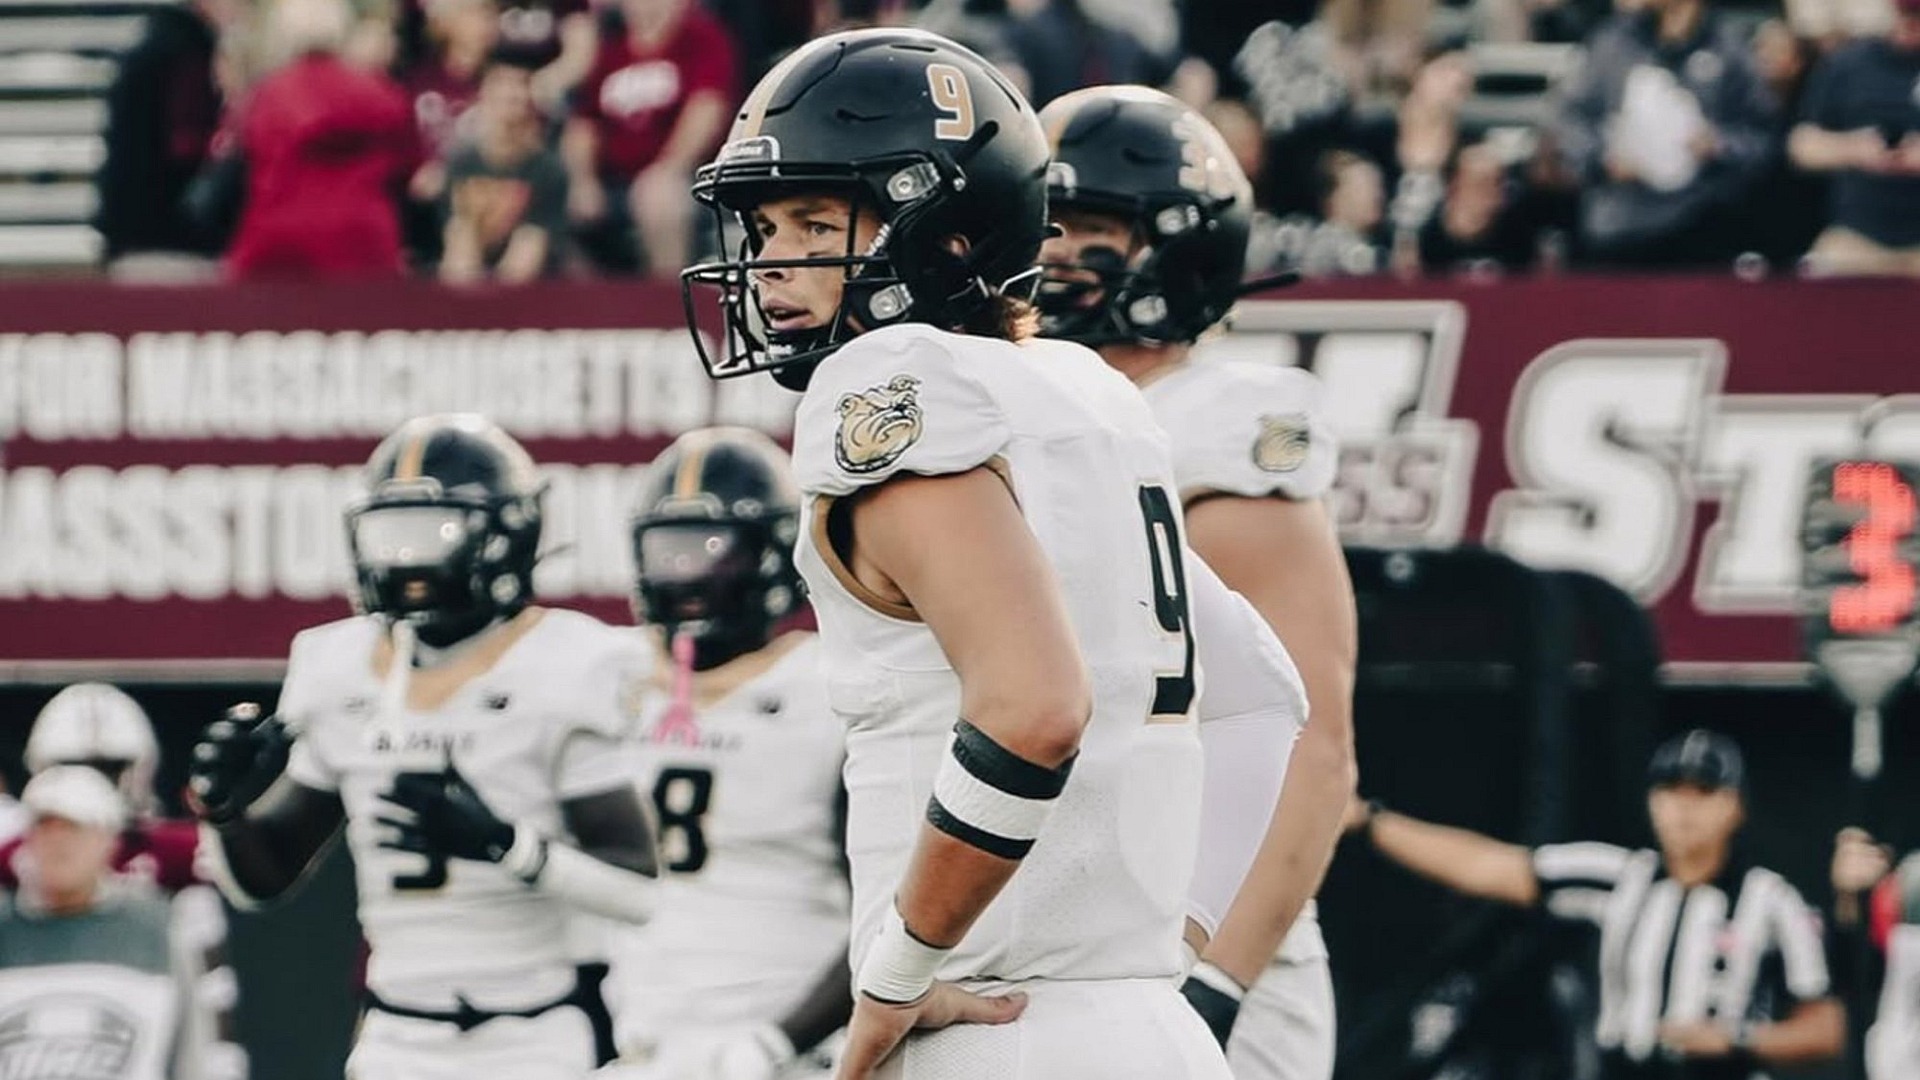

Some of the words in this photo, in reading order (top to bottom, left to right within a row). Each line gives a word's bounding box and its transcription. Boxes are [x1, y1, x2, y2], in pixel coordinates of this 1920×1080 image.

[926, 63, 975, 140] 9
[1137, 484, 1196, 718] 9
[1829, 461, 1917, 634] 3
[652, 766, 713, 875] 8
